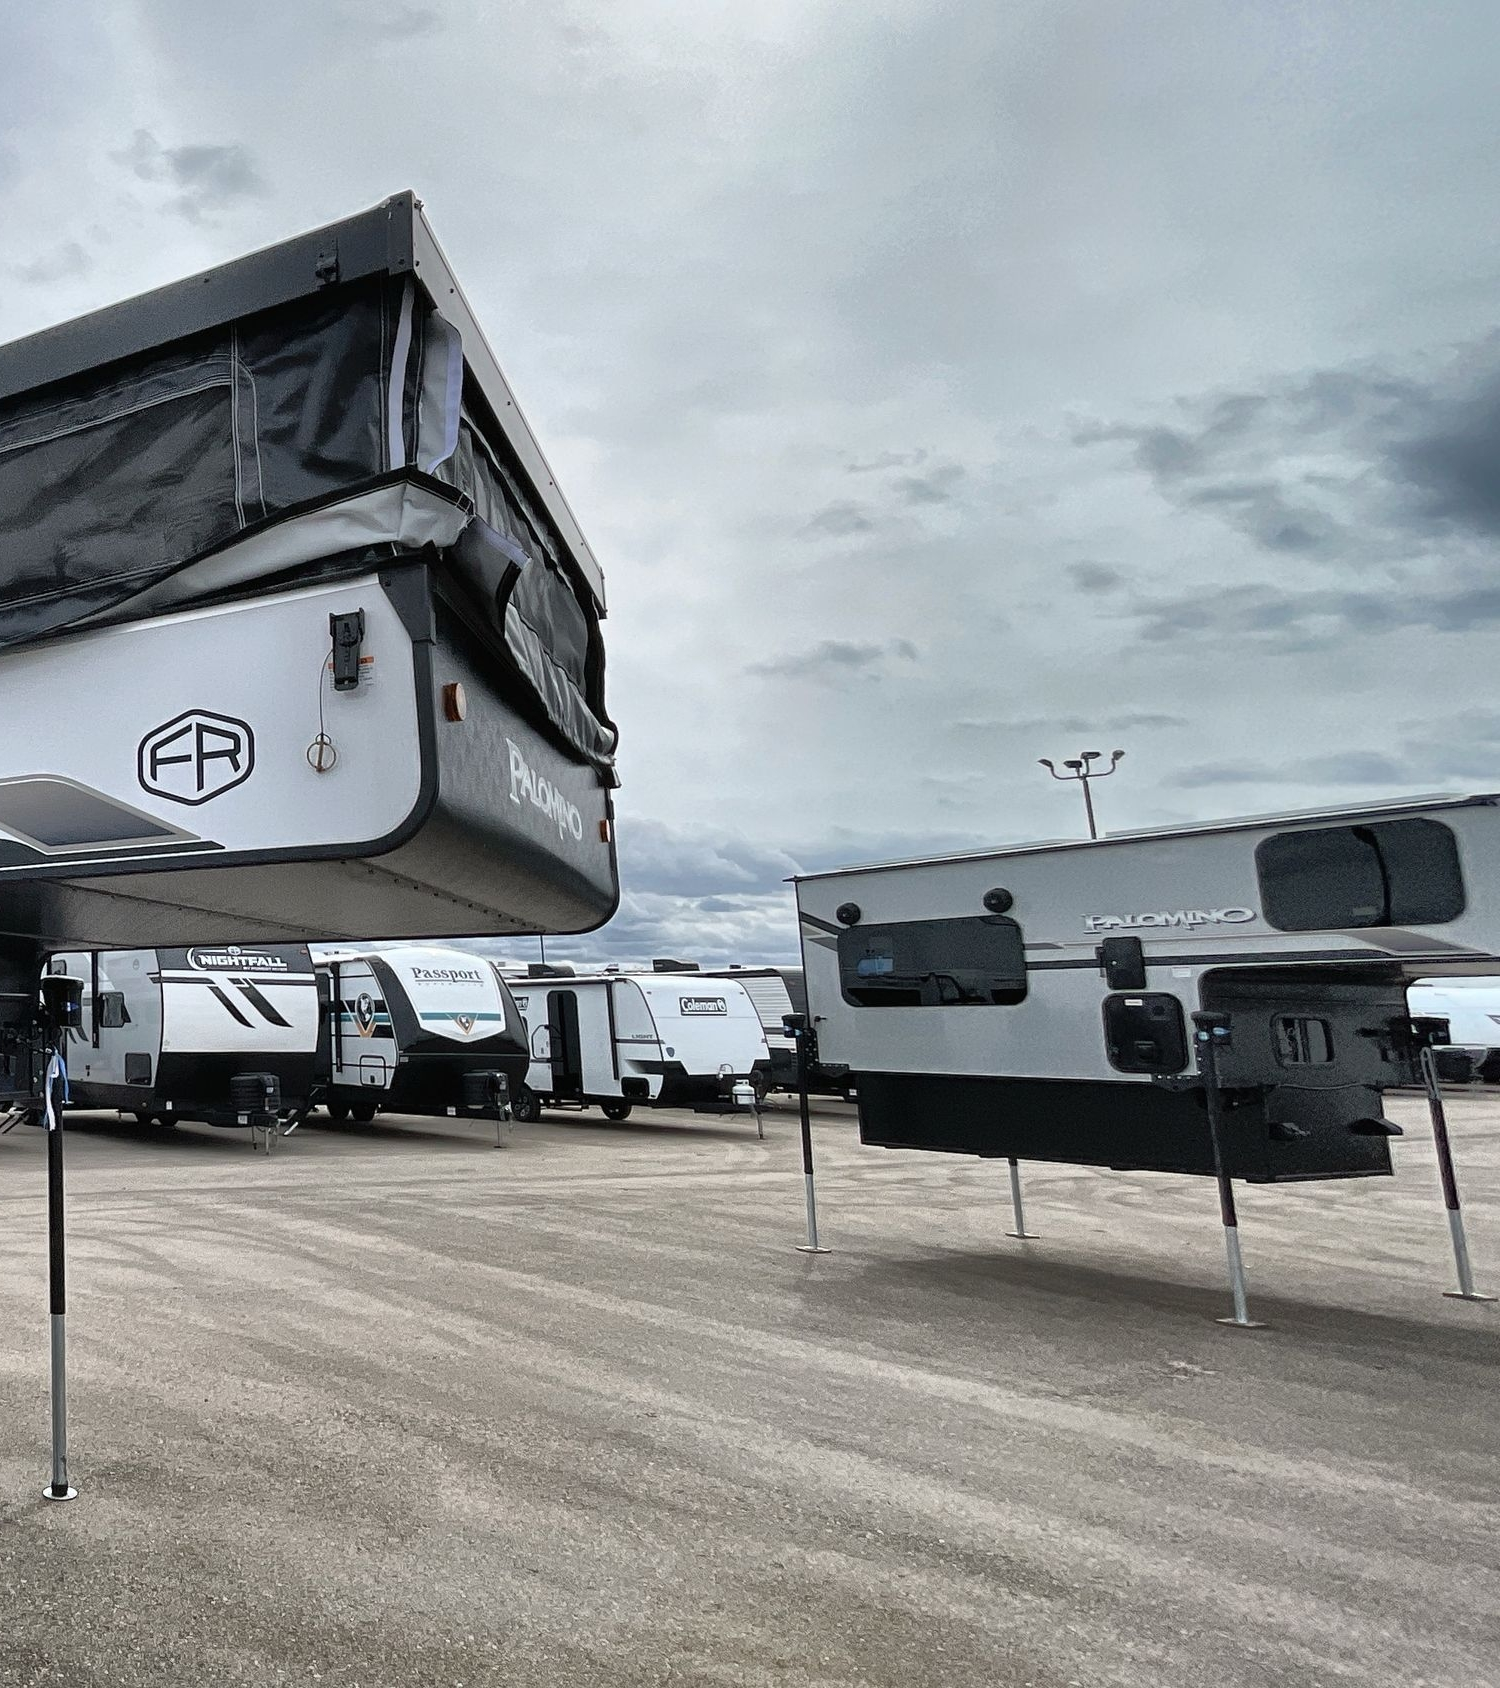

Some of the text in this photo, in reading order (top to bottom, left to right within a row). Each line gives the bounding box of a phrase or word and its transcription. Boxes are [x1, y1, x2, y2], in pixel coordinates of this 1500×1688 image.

[150, 722, 241, 792] FR
[505, 737, 583, 841] PALOMINO
[1081, 906, 1257, 934] PALOMINO
[198, 954, 287, 967] NIGHTFALL
[410, 967, 482, 983] Passport
[681, 998, 718, 1011] Coleman
